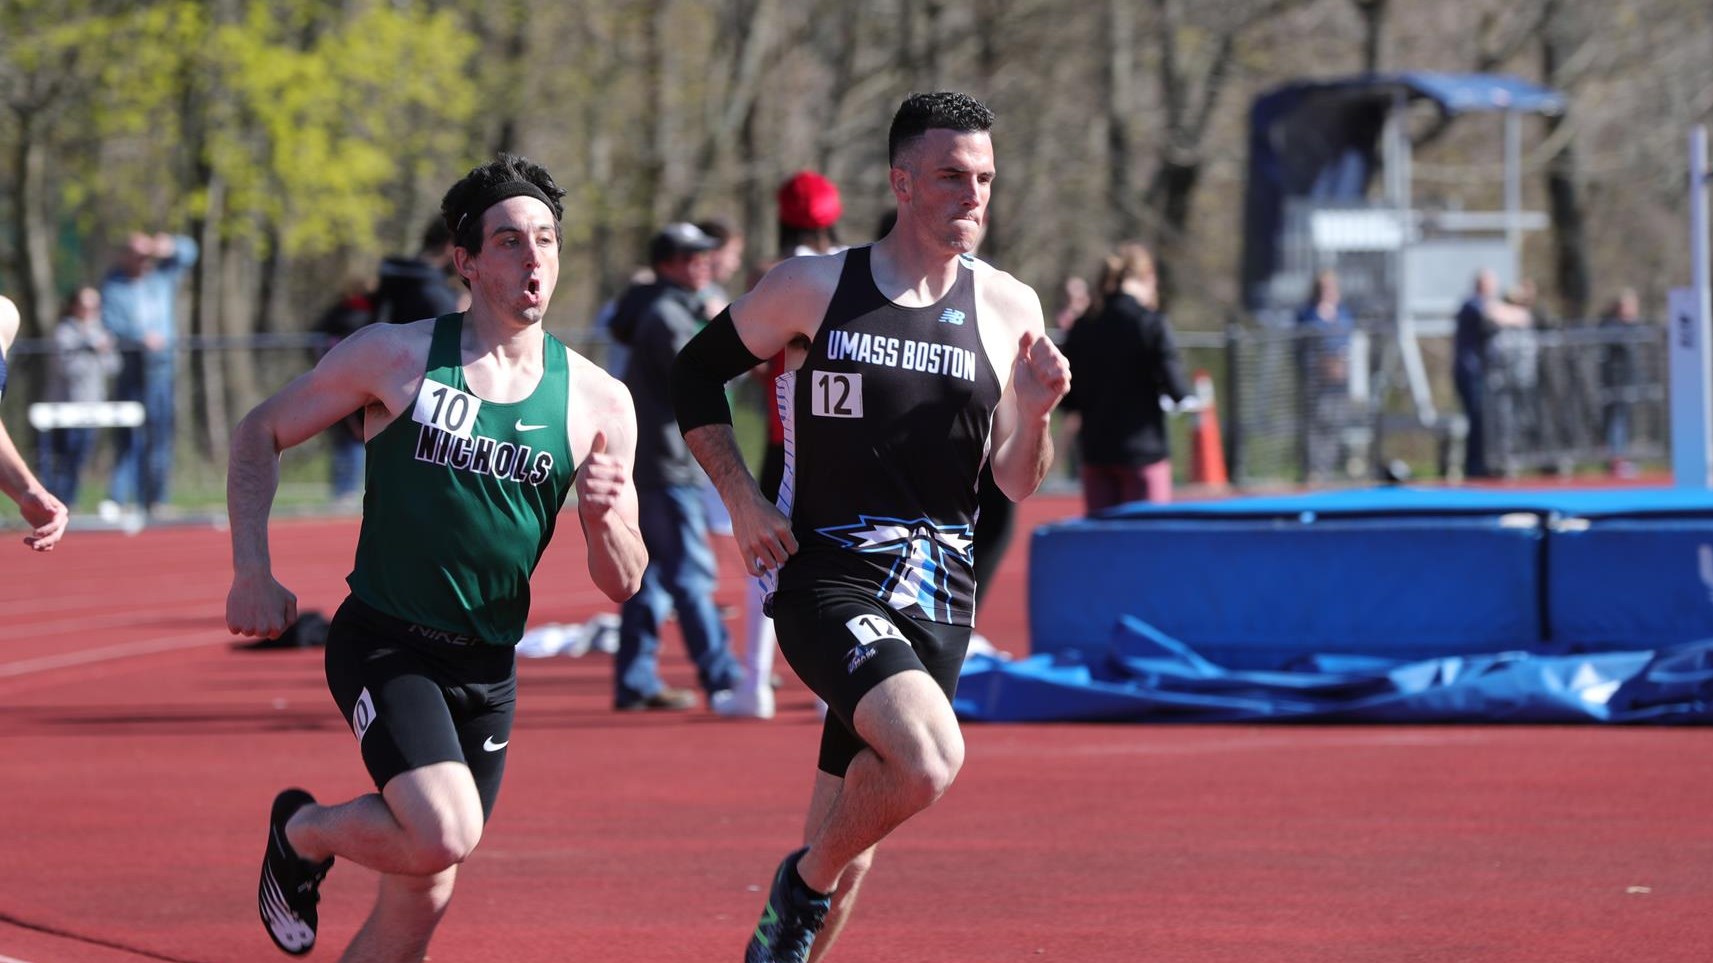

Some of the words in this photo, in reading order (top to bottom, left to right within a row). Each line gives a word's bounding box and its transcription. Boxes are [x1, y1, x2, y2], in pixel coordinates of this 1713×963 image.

[827, 330, 900, 368] UMASS
[901, 340, 976, 382] BOSTON
[432, 387, 469, 432] 10
[818, 374, 853, 416] 12
[415, 425, 554, 486] NICHOLS
